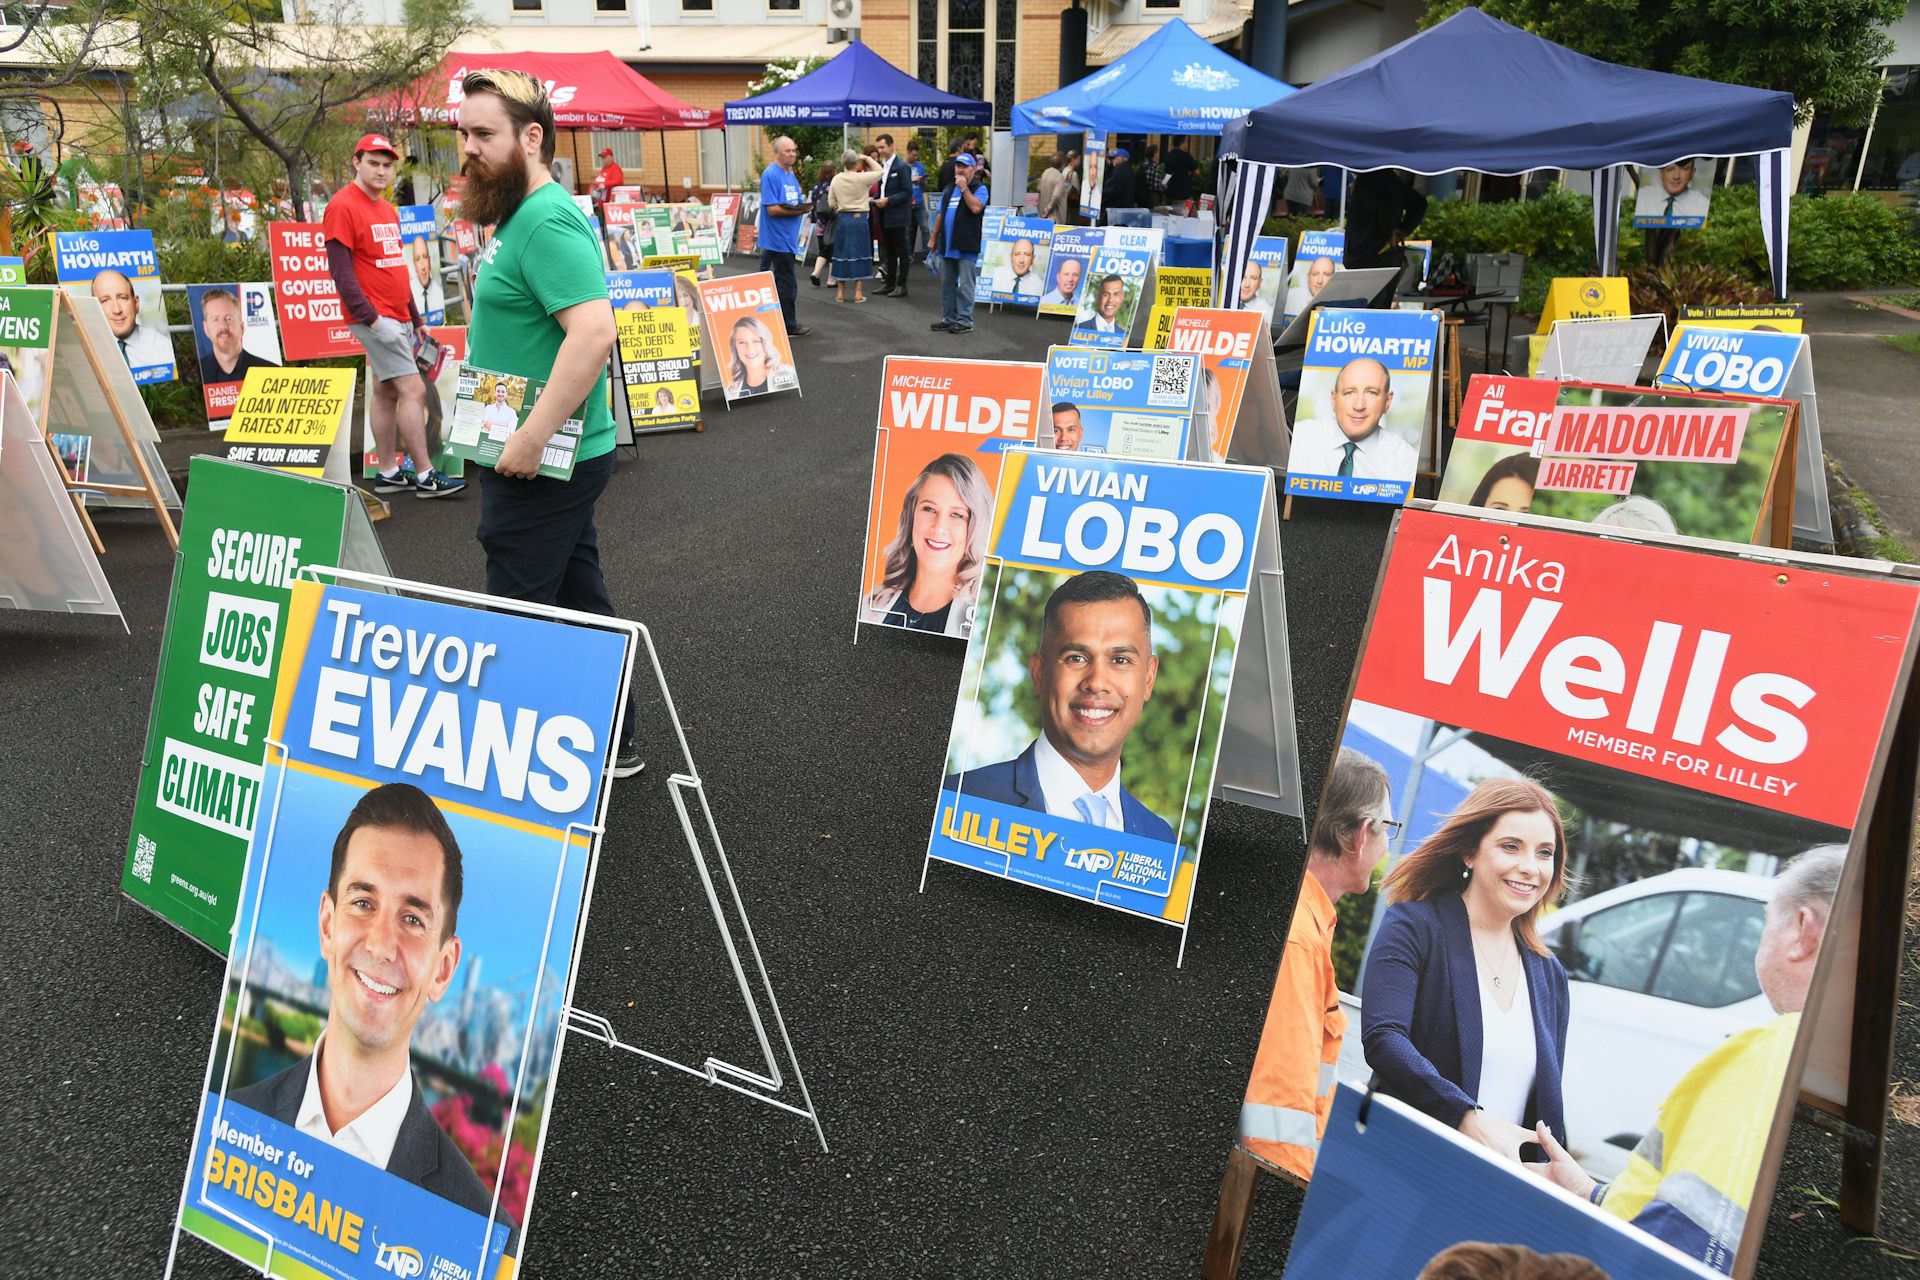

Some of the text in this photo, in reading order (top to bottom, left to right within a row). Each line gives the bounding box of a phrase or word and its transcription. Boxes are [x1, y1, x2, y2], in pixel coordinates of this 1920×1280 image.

[420, 106, 460, 122] Well
[587, 112, 598, 122] for
[600, 113, 625, 125] Lilley
[726, 105, 811, 120] TREVOR EVANS MP
[849, 104, 898, 117] TREVOR
[901, 106, 939, 118] EVANS
[941, 110, 955, 119] MP
[1169, 106, 1198, 118] Luke
[1178, 121, 1206, 130] Federal
[400, 210, 415, 222] Luke
[1005, 218, 1025, 227] Luke
[401, 221, 435, 234] HOWARTH
[1004, 227, 1051, 239] HOWARTH
[58, 237, 100, 253] Luke
[282, 232, 312, 247] THE
[1055, 234, 1081, 244] PETER
[1120, 235, 1147, 247] CLEAR
[1304, 235, 1327, 246] Luke
[1053, 243, 1089, 254] DUTTON
[1100, 249, 1126, 258] VIVIAN
[1249, 250, 1282, 261] ARTH
[62, 251, 154, 269] HOWARTH
[280, 256, 301, 271] TO
[1095, 257, 1146, 276] LOBO
[137, 266, 155, 276] MP
[282, 280, 337, 296] GOVER
[1159, 275, 1204, 286] PROVISIONAL
[1160, 286, 1176, 295] PAID
[1177, 287, 1186, 296] AT
[1188, 287, 1200, 296] THE
[705, 287, 775, 313] WILDE
[1165, 297, 1210, 308] OF THE YEAR
[285, 304, 339, 320] TO VOT
[632, 312, 655, 323] FREE
[1687, 309, 1704, 317] Vote
[1715, 308, 1739, 316] United
[1740, 308, 1773, 316] Australia
[1774, 308, 1795, 317] Party
[617, 325, 635, 336] AFE
[638, 324, 656, 335] AND
[1177, 318, 1211, 328] MICHELLE
[1319, 317, 1366, 334] Luke
[330, 330, 351, 341] Labor
[645, 335, 675, 346] DEBTS
[1174, 328, 1251, 357] WILDE
[1687, 334, 1744, 353] VIVIAN
[633, 347, 663, 359] WIPED
[1315, 336, 1432, 356] HOWARTH
[623, 359, 690, 374] CATION SHOULD
[1055, 357, 1131, 370] VOTE 1 LNP
[1403, 356, 1428, 369] MP
[640, 372, 657, 383] YOU
[659, 370, 680, 381] FREE
[1671, 350, 1784, 393] LOBO
[261, 377, 332, 395] CAP HOME
[891, 375, 952, 390] MICHELLE
[1052, 374, 1133, 390] Vivian LOBO
[208, 386, 239, 398] DANIEL
[1050, 388, 1113, 401] LNP for Lilley
[1483, 385, 1505, 398] Ali
[238, 397, 342, 415] LOAN INTEREST
[890, 390, 1031, 438] WILDE
[239, 417, 327, 436] RATES AT 3%
[1554, 412, 1737, 458] MADONNA
[227, 446, 320, 463] SAVE YOUR HOME
[1036, 465, 1148, 501] VIVIAN
[1543, 463, 1633, 492] JARRETT
[1289, 477, 1376, 496] PETRIE LNP
[1020, 495, 1244, 581] LOBO
[207, 528, 302, 590] SECURE
[1427, 533, 1566, 594] Anika
[205, 607, 271, 668] JOBS
[326, 599, 497, 688] Trevor
[1423, 575, 1817, 765] Wells
[193, 682, 256, 747] SAFE
[308, 665, 595, 814] EVANS
[1566, 726, 1799, 798] MEMBER FOR LILLEY
[940, 806, 1058, 861] LILLEY
[1064, 848, 1112, 873] LNP
[1124, 852, 1163, 869] LIBERAL
[1117, 871, 1151, 886] PARTY
[1121, 861, 1167, 881] NATIONAL
[211, 1116, 314, 1180] Member for
[203, 1145, 364, 1254] BRISBANE
[375, 1242, 423, 1279] LNP
